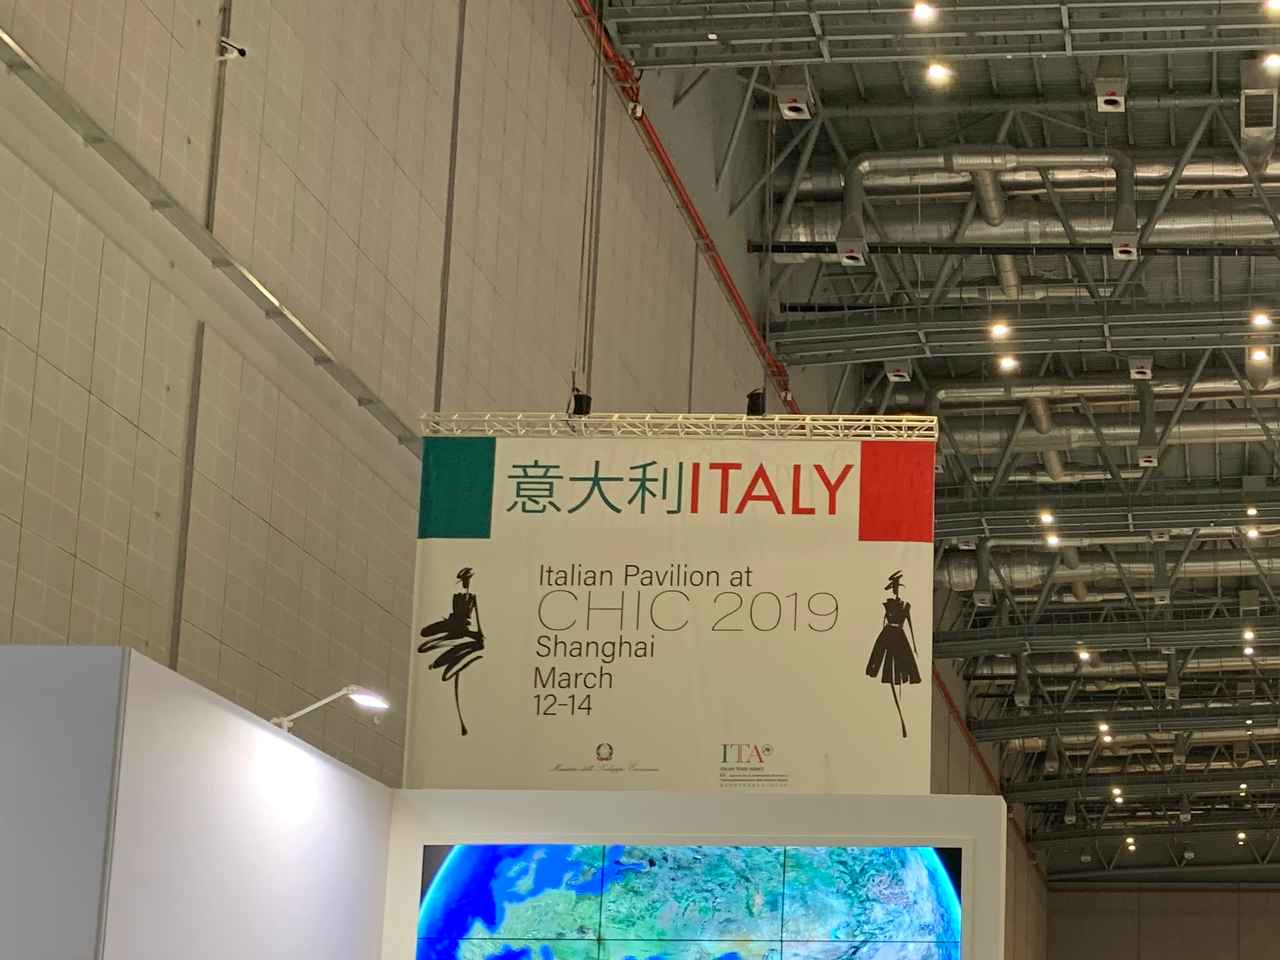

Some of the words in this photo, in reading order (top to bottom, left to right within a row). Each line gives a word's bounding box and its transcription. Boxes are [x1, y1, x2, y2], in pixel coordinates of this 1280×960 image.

[538, 564, 614, 587] Italian
[624, 564, 721, 588] Pavilion
[730, 566, 753, 588] at
[538, 589, 690, 632] CHIC
[711, 591, 839, 632] 2019
[536, 634, 656, 664] Shanghai
[533, 665, 613, 690] March
[533, 693, 593, 717] 12-14
[720, 743, 764, 763] ITA
